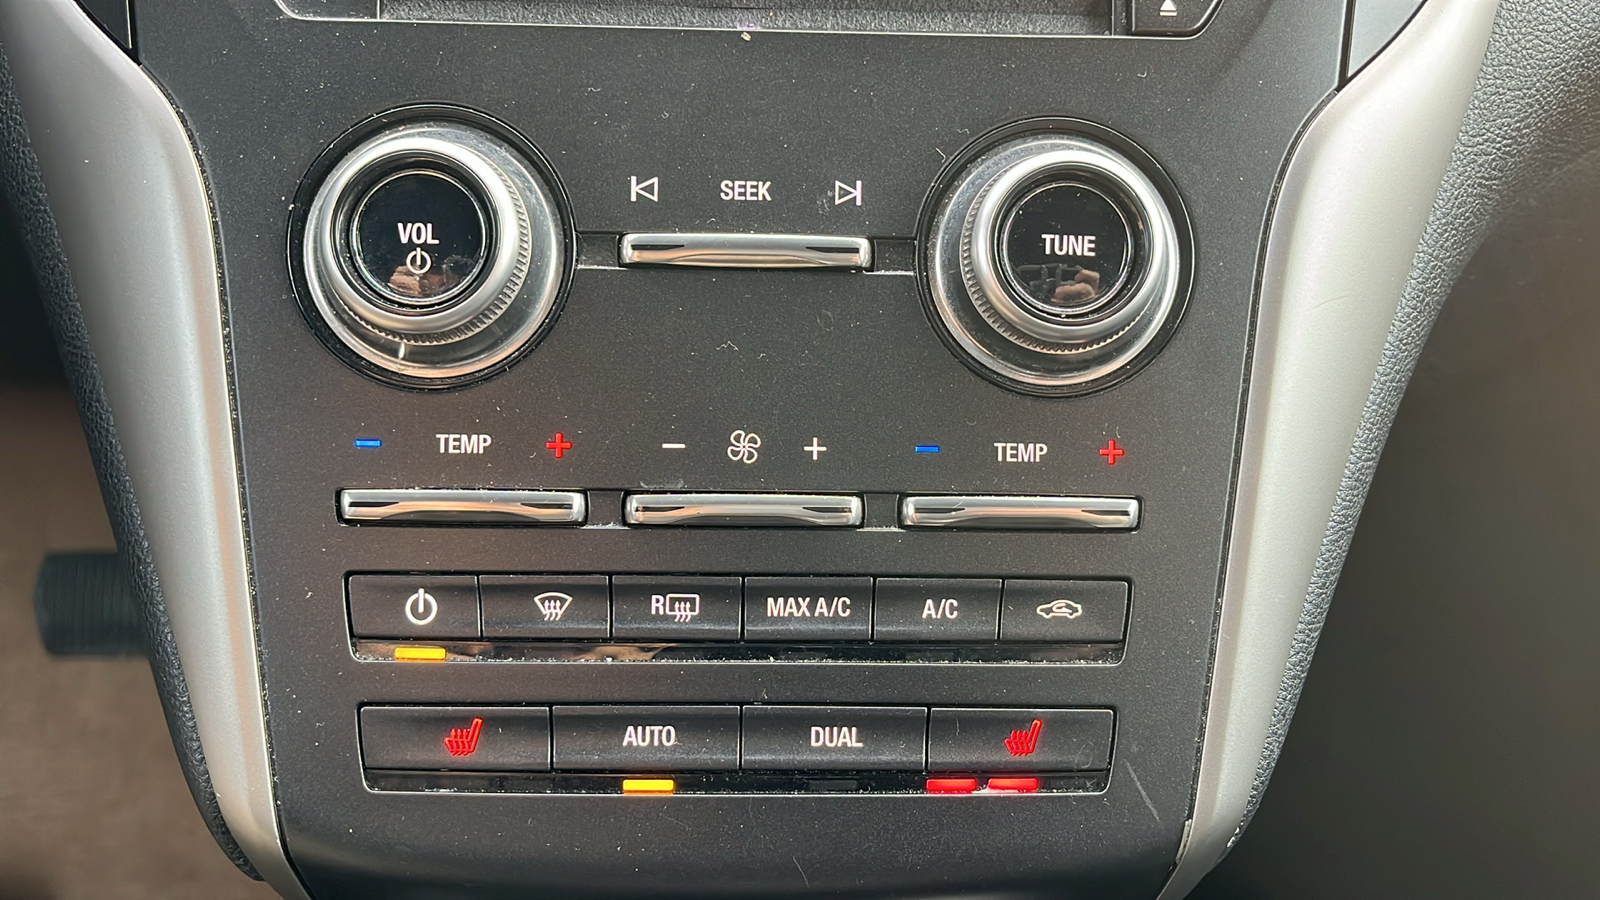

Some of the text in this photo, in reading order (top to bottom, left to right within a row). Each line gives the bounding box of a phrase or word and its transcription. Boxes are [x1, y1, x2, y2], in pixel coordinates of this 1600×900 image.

[720, 180, 772, 201] SEEK
[397, 222, 440, 246] VOL
[1041, 233, 1096, 257] TUNE
[435, 433, 492, 455] TEMP
[993, 442, 1049, 463] TEMP
[651, 594, 664, 615] R
[767, 597, 851, 618] MAX A/C
[921, 598, 958, 619] A/C
[622, 725, 676, 747] AUTO
[810, 726, 864, 748] DUAL
